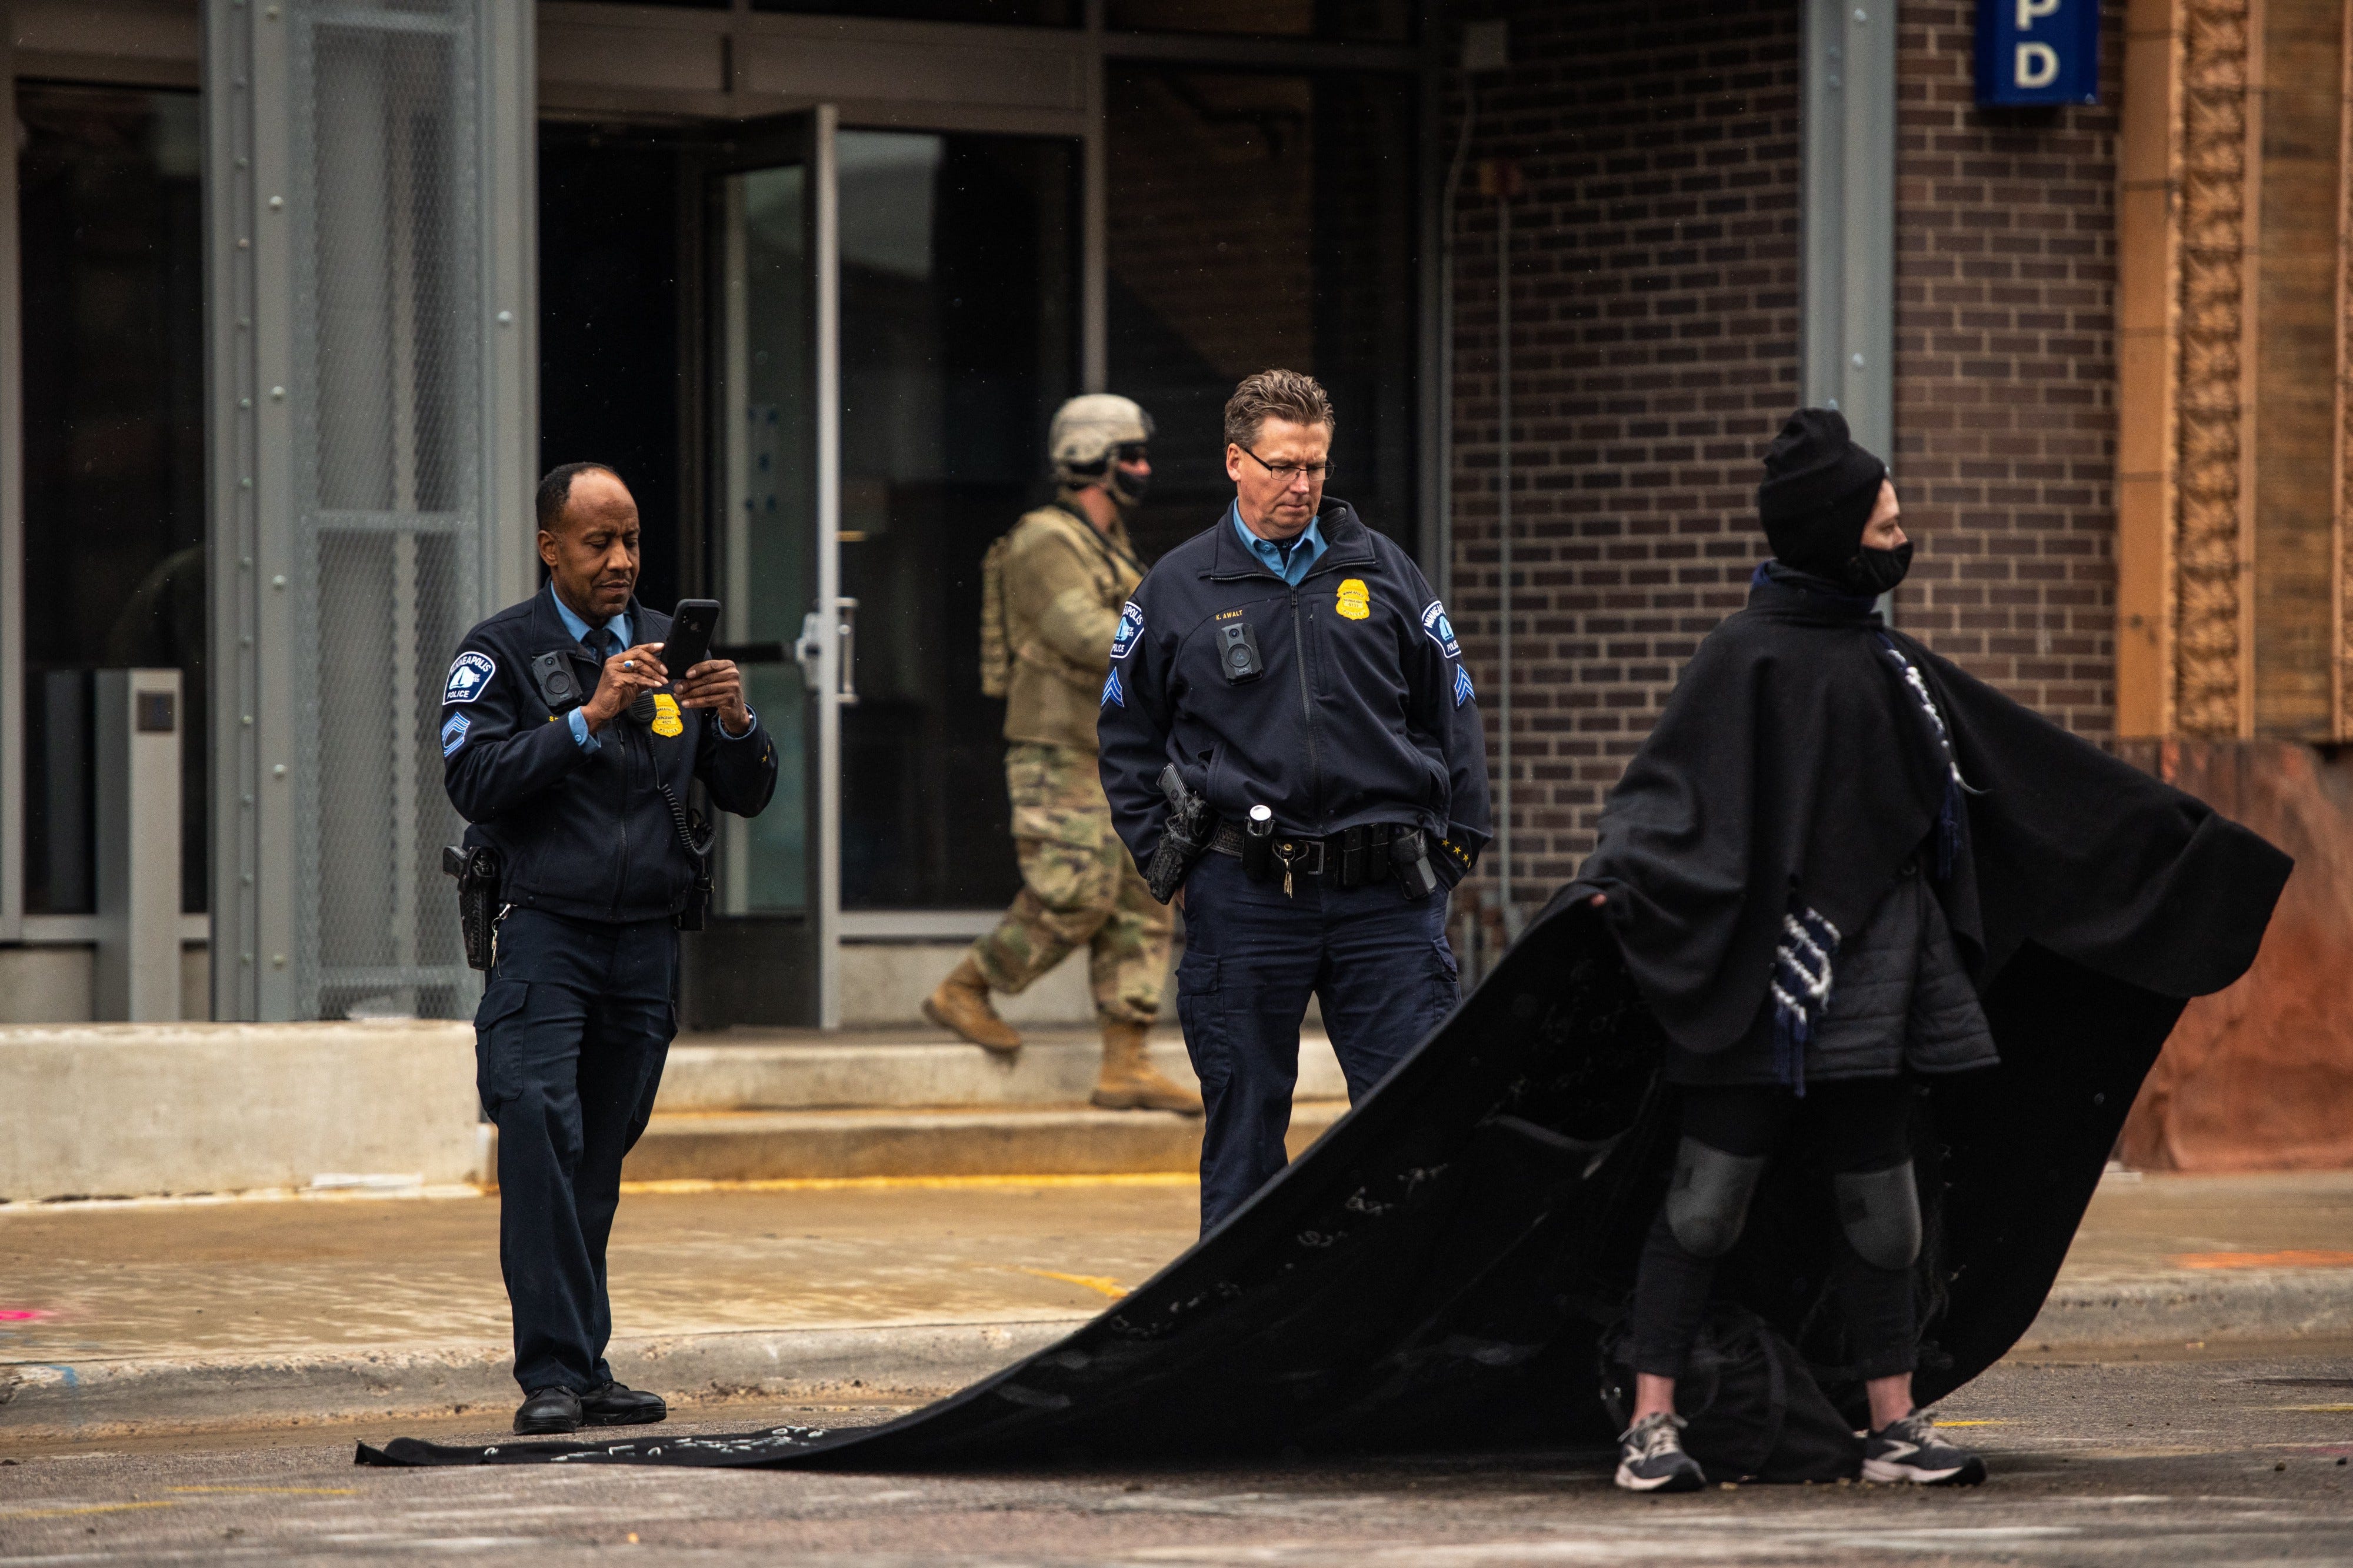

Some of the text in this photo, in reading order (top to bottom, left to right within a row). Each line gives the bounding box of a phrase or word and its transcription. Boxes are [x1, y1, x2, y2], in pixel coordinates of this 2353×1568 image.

[1223, 610, 1243, 619] AWALT
[1112, 643, 1125, 652] POLICE
[450, 656, 491, 676] MINNEAPOLIS
[447, 690, 470, 699] POLICE
